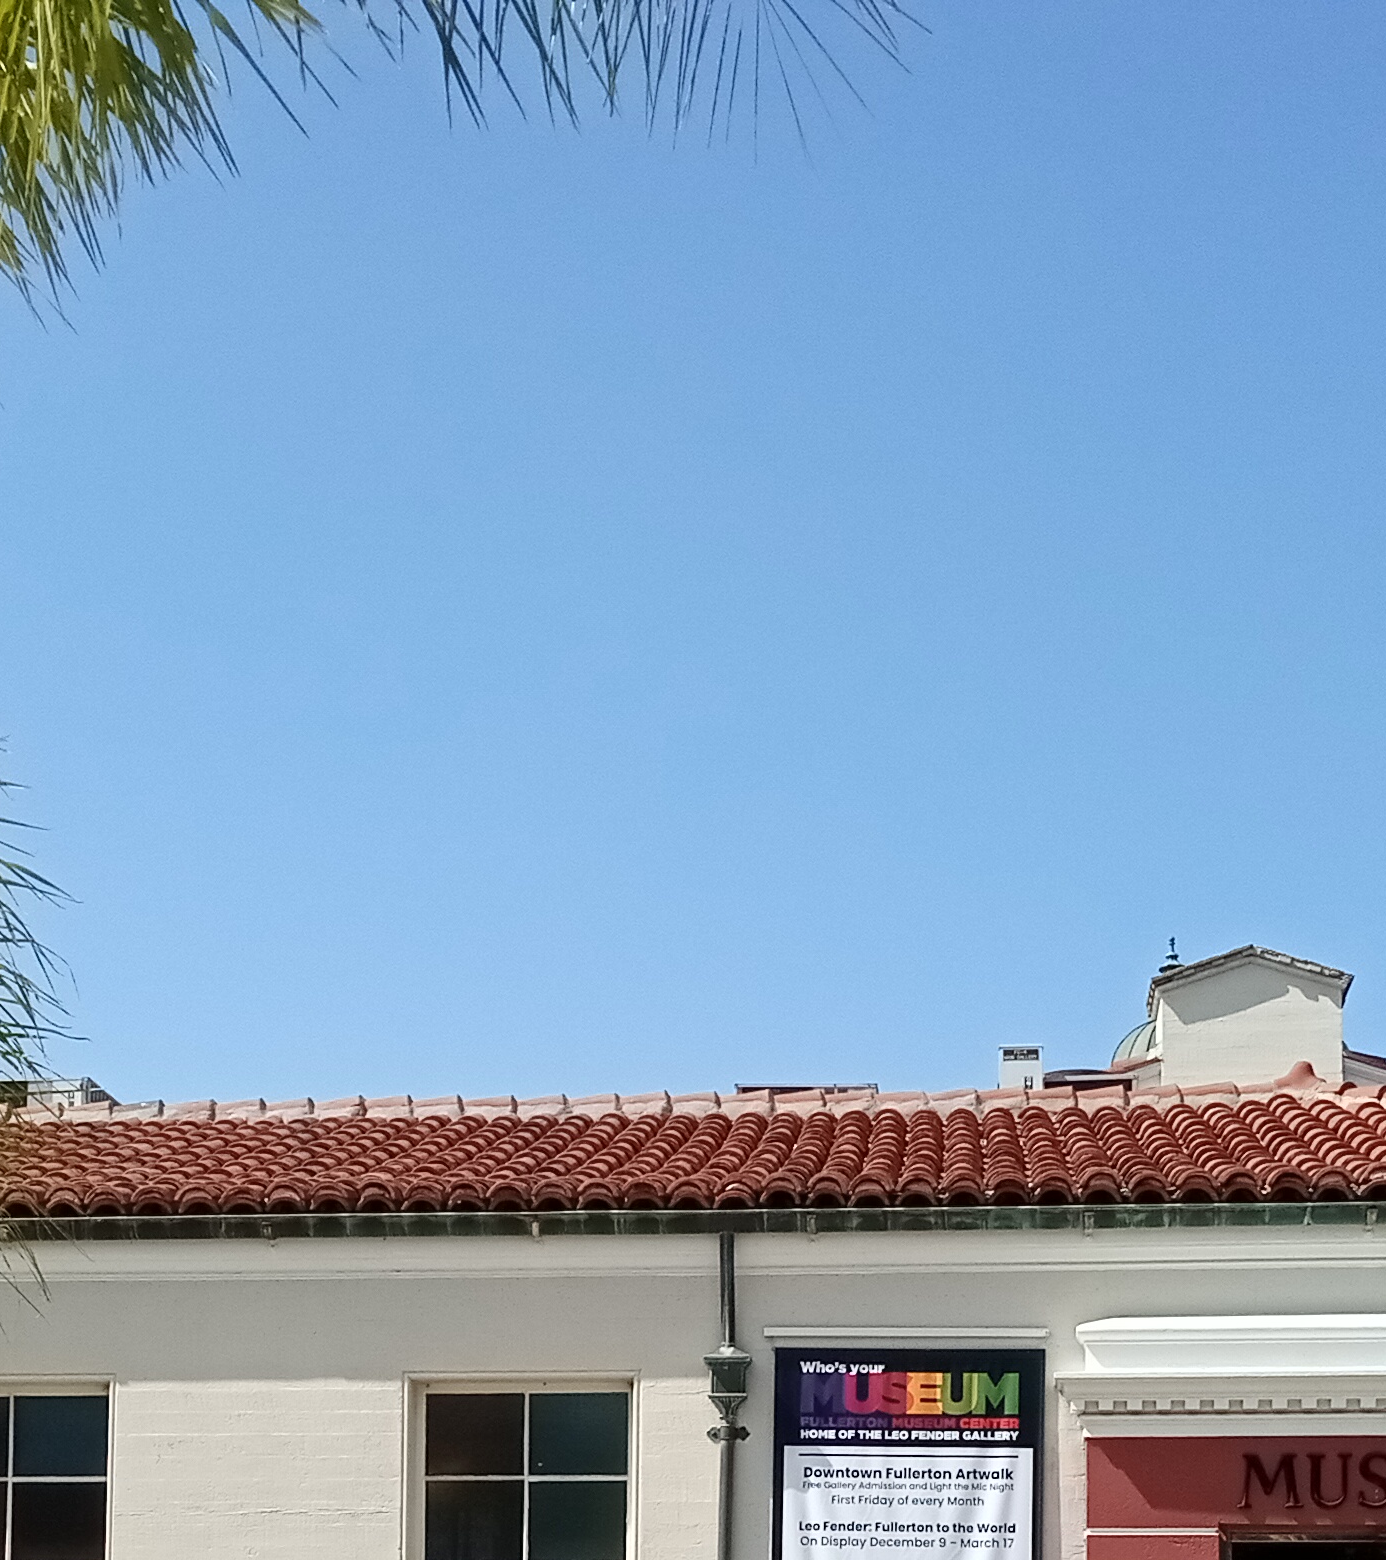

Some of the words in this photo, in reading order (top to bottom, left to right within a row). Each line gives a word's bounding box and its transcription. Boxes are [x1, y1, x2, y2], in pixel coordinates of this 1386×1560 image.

[800, 1362, 847, 1374] Who's
[850, 1363, 885, 1376] your
[800, 1372, 1020, 1415] MUSEUM
[800, 1417, 889, 1428] FULLERTON
[892, 1418, 956, 1429] MUSEUM
[960, 1418, 1019, 1429] CENTER
[800, 1430, 836, 1439] HOME
[839, 1430, 855, 1439] OF
[858, 1430, 882, 1439] THE
[885, 1430, 909, 1440] LEO
[911, 1431, 960, 1440] FENDER
[962, 1431, 1019, 1441] GALLERY
[803, 1467, 882, 1479] Downtown
[886, 1468, 952, 1480] Fullerton
[956, 1468, 1013, 1480] Artwalk
[802, 1481, 822, 1489] Free
[824, 1482, 856, 1491] Gallery
[859, 1482, 907, 1490] Admission
[930, 1483, 952, 1492] Light
[954, 1483, 969, 1491] the
[971, 1483, 986, 1491] Mic
[990, 1483, 1014, 1492] Night
[831, 1495, 856, 1505] First
[858, 1496, 895, 1507] Friday
[898, 1496, 909, 1506] of
[912, 1497, 944, 1508] every
[947, 1496, 984, 1506] Month
[798, 1522, 820, 1532] Leo
[823, 1522, 872, 1533] Fender:
[875, 1522, 933, 1533] Fullerton
[936, 1523, 950, 1533] to
[952, 1522, 974, 1533] the
[977, 1522, 1016, 1534] World
[800, 1536, 818, 1547] On
[821, 1537, 866, 1550] Display
[870, 1537, 935, 1548] December
[939, 1538, 946, 1548] 9
[960, 1538, 1000, 1549] March
[1003, 1539, 1014, 1549] 17
